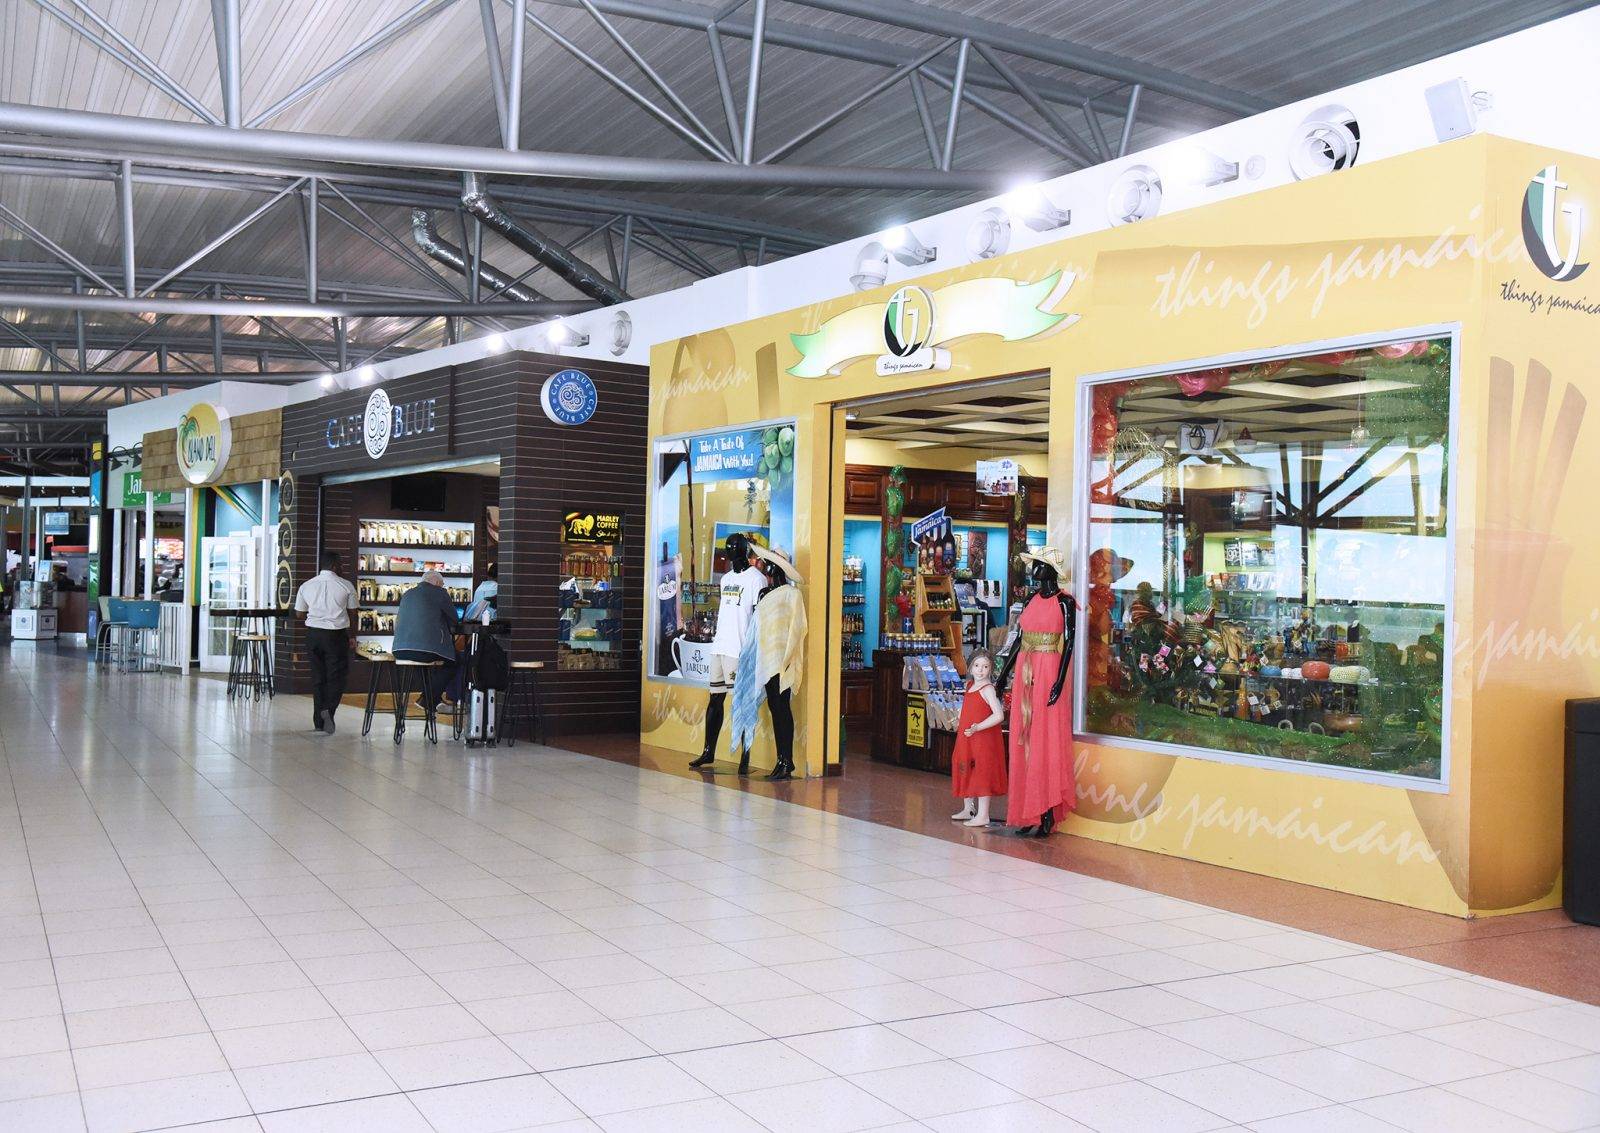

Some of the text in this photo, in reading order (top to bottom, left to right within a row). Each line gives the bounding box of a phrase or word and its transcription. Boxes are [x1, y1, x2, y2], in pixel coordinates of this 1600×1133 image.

[1150, 250, 1300, 330] things
[1500, 279, 1544, 314] things
[884, 360, 923, 372] things jamaican
[570, 372, 591, 389] BLUE
[393, 398, 436, 439] BLUE
[712, 439, 720, 451] A
[695, 454, 723, 472] JAMAICA
[914, 517, 942, 539] Jamaica
[1073, 748, 1441, 864] hings jamaican
